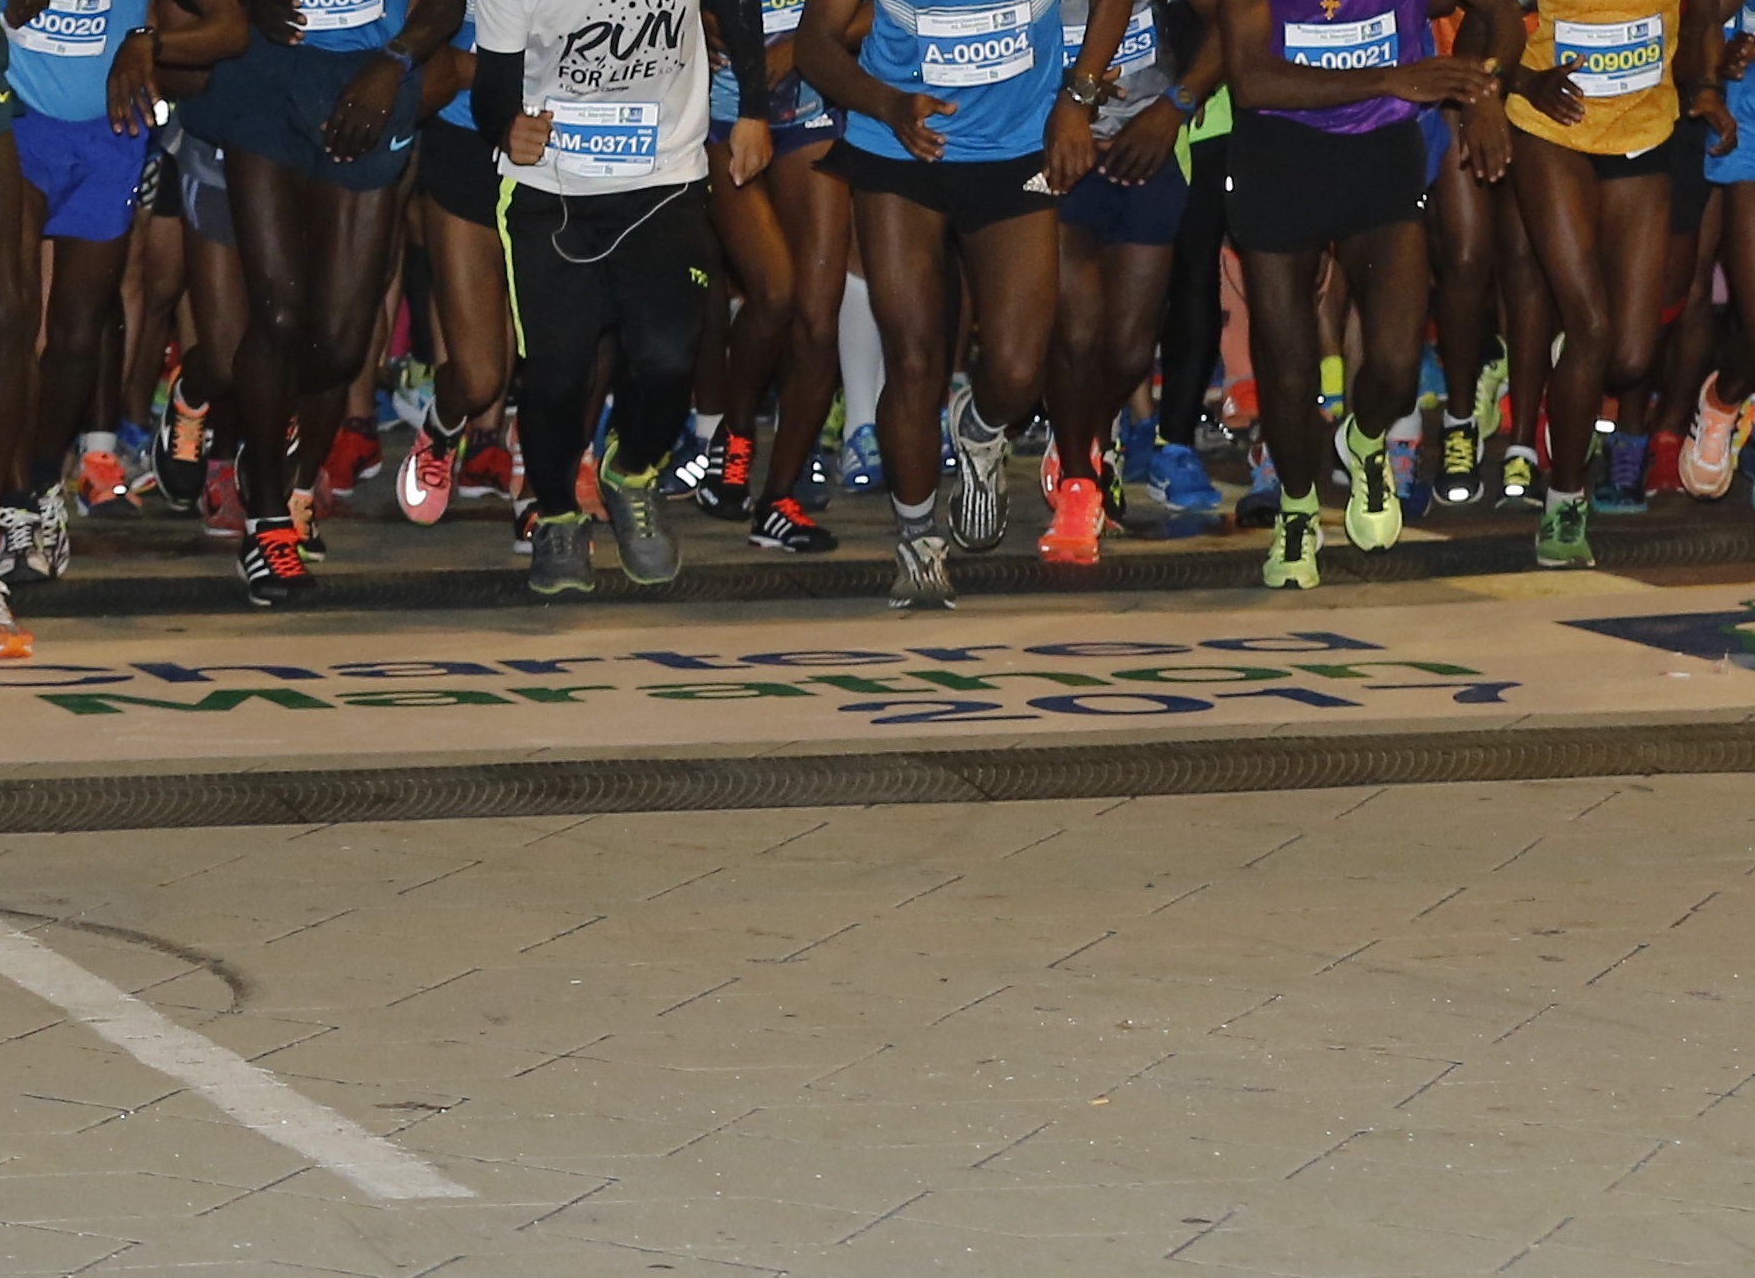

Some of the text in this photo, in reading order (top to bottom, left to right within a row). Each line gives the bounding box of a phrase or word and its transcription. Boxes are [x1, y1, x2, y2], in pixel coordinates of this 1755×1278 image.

[559, 6, 687, 63] RUN
[924, 32, 1029, 64] A-00004
[558, 60, 658, 88] FOR LIFE
[1293, 41, 1391, 70] A-00021
[34, 660, 1483, 716] Marathon
[837, 680, 1525, 726] 2017
